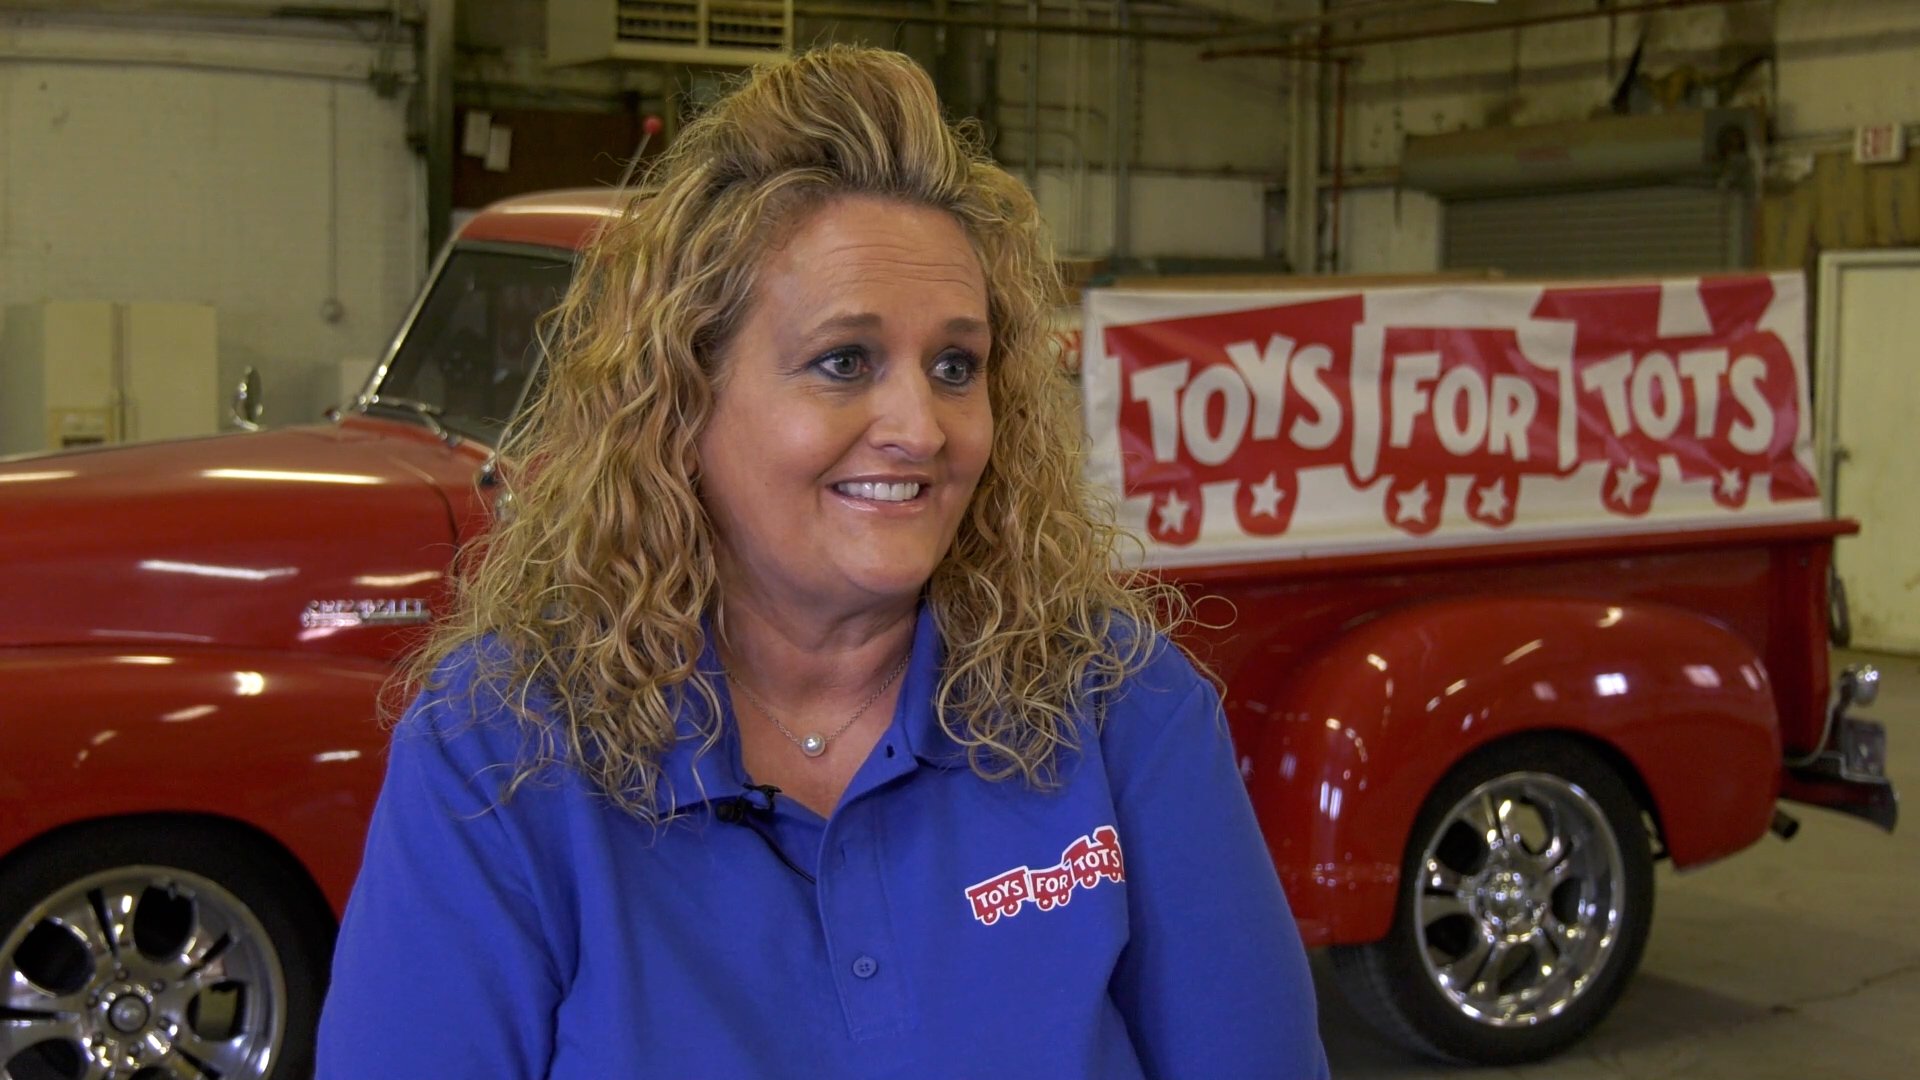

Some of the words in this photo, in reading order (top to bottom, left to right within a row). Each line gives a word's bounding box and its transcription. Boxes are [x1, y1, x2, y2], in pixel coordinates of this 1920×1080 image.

[1131, 334, 1343, 465] TOYS
[1390, 352, 1537, 461] FOR
[1583, 349, 1775, 456] TOTS
[976, 880, 1023, 908] TOYS
[1036, 874, 1068, 893] FOR
[1074, 848, 1120, 871] TOTS
